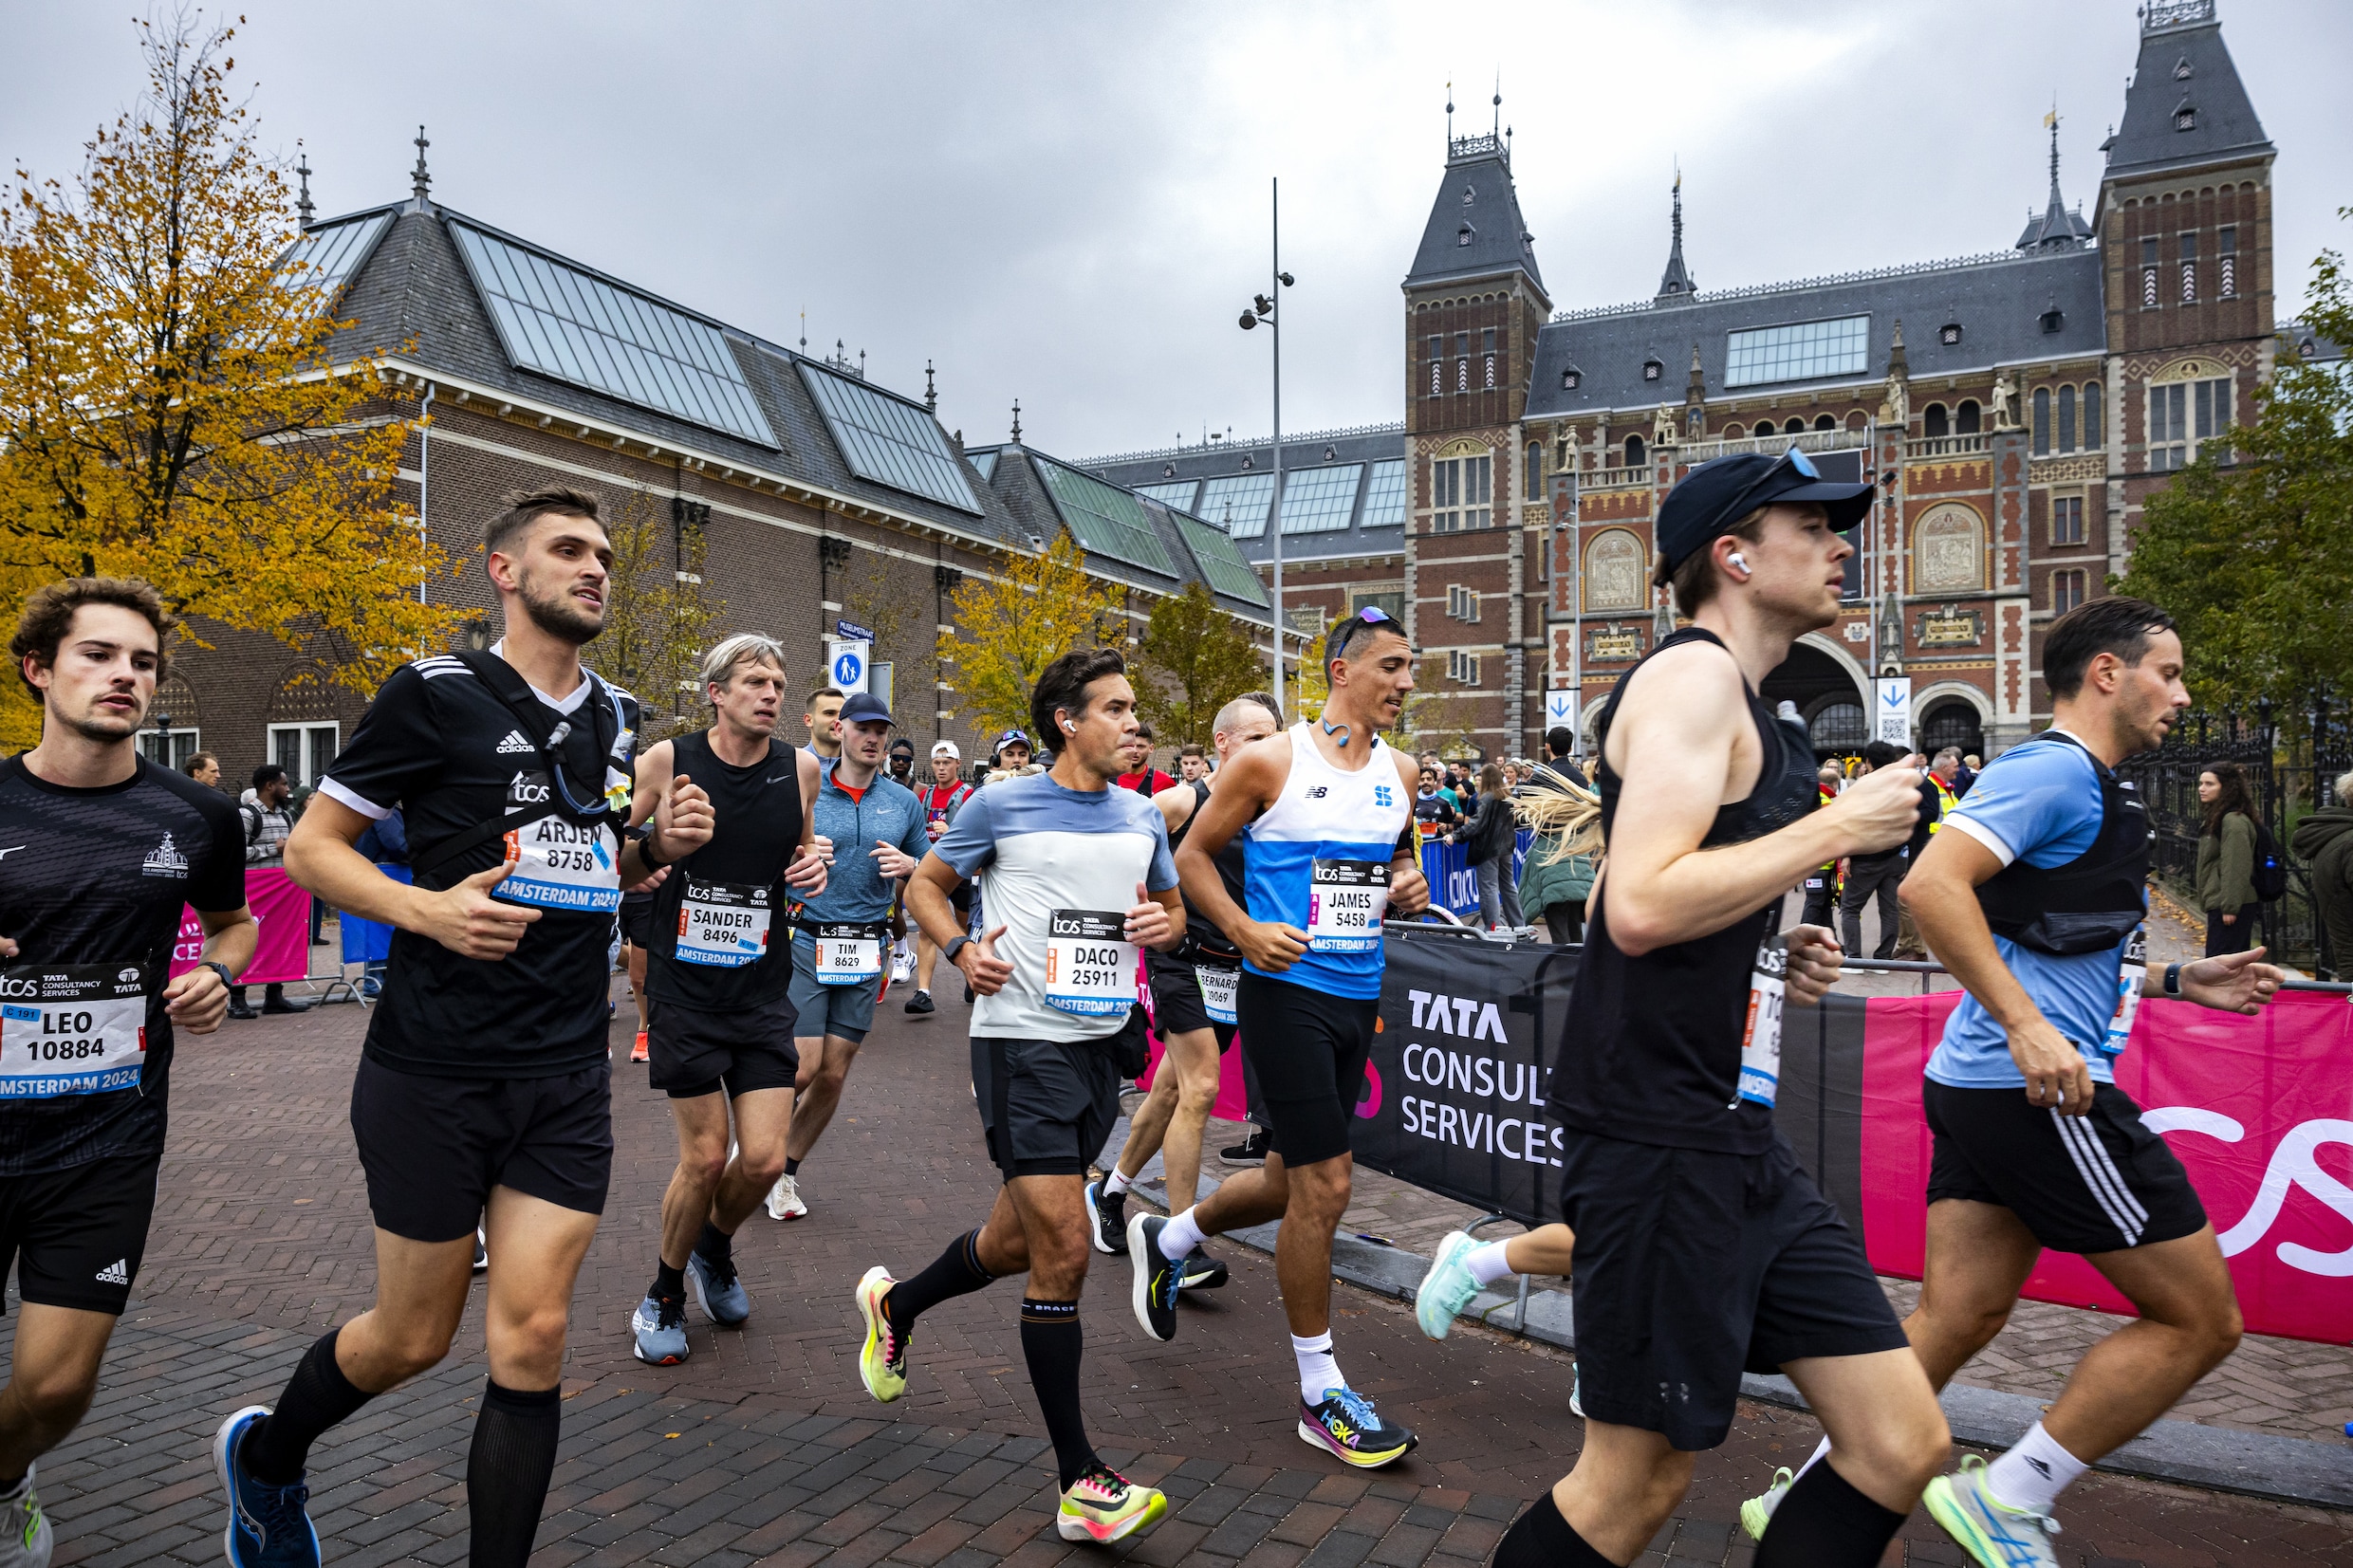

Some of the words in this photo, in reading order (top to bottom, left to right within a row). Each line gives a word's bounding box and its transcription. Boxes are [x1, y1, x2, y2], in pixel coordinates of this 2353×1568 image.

[840, 621, 874, 638] MUSEUMSTRAAT
[496, 745, 535, 753] adidas
[536, 821, 602, 846] ARJEN
[547, 850, 593, 872] 8758
[1315, 865, 1339, 881] tcs
[498, 879, 590, 906] AMSTERDAM
[591, 893, 618, 907] 2024
[688, 883, 710, 900] tcs
[1329, 893, 1371, 909] JAMES
[693, 909, 752, 929] SANDER
[1053, 915, 1081, 934] tcs
[1336, 913, 1365, 927] 5458
[703, 929, 737, 944] 8496
[1309, 939, 1364, 950] AMSTERDAM
[676, 948, 736, 965] AMSTERDAM
[738, 956, 756, 966] 20
[838, 944, 857, 954] TIM
[1075, 948, 1118, 967] DACO
[835, 956, 860, 967] 8629
[0, 975, 37, 997] tcs
[43, 981, 102, 989] CONSULTANCY
[818, 974, 861, 983] AMSTERDAM
[1072, 969, 1117, 987] 25911
[1201, 975, 1238, 990] BERNARD
[42, 988, 80, 997] SERVICES
[114, 984, 141, 993] TATA
[7, 1007, 13, 1016] C
[17, 1009, 35, 1019] 191
[1047, 997, 1114, 1012] AMSTERDAM
[1115, 1001, 1133, 1013] 202
[43, 1011, 92, 1035] LEO
[1408, 988, 1509, 1044] TATA
[27, 1038, 104, 1061] 10884
[0, 1077, 98, 1095] MSTERDAM
[102, 1068, 139, 1088] 2024
[1402, 1042, 1553, 1107] CONSUL
[1401, 1095, 1564, 1168] SERVICES
[96, 1272, 128, 1285] adidas
[1320, 1409, 1361, 1450] HOKA
